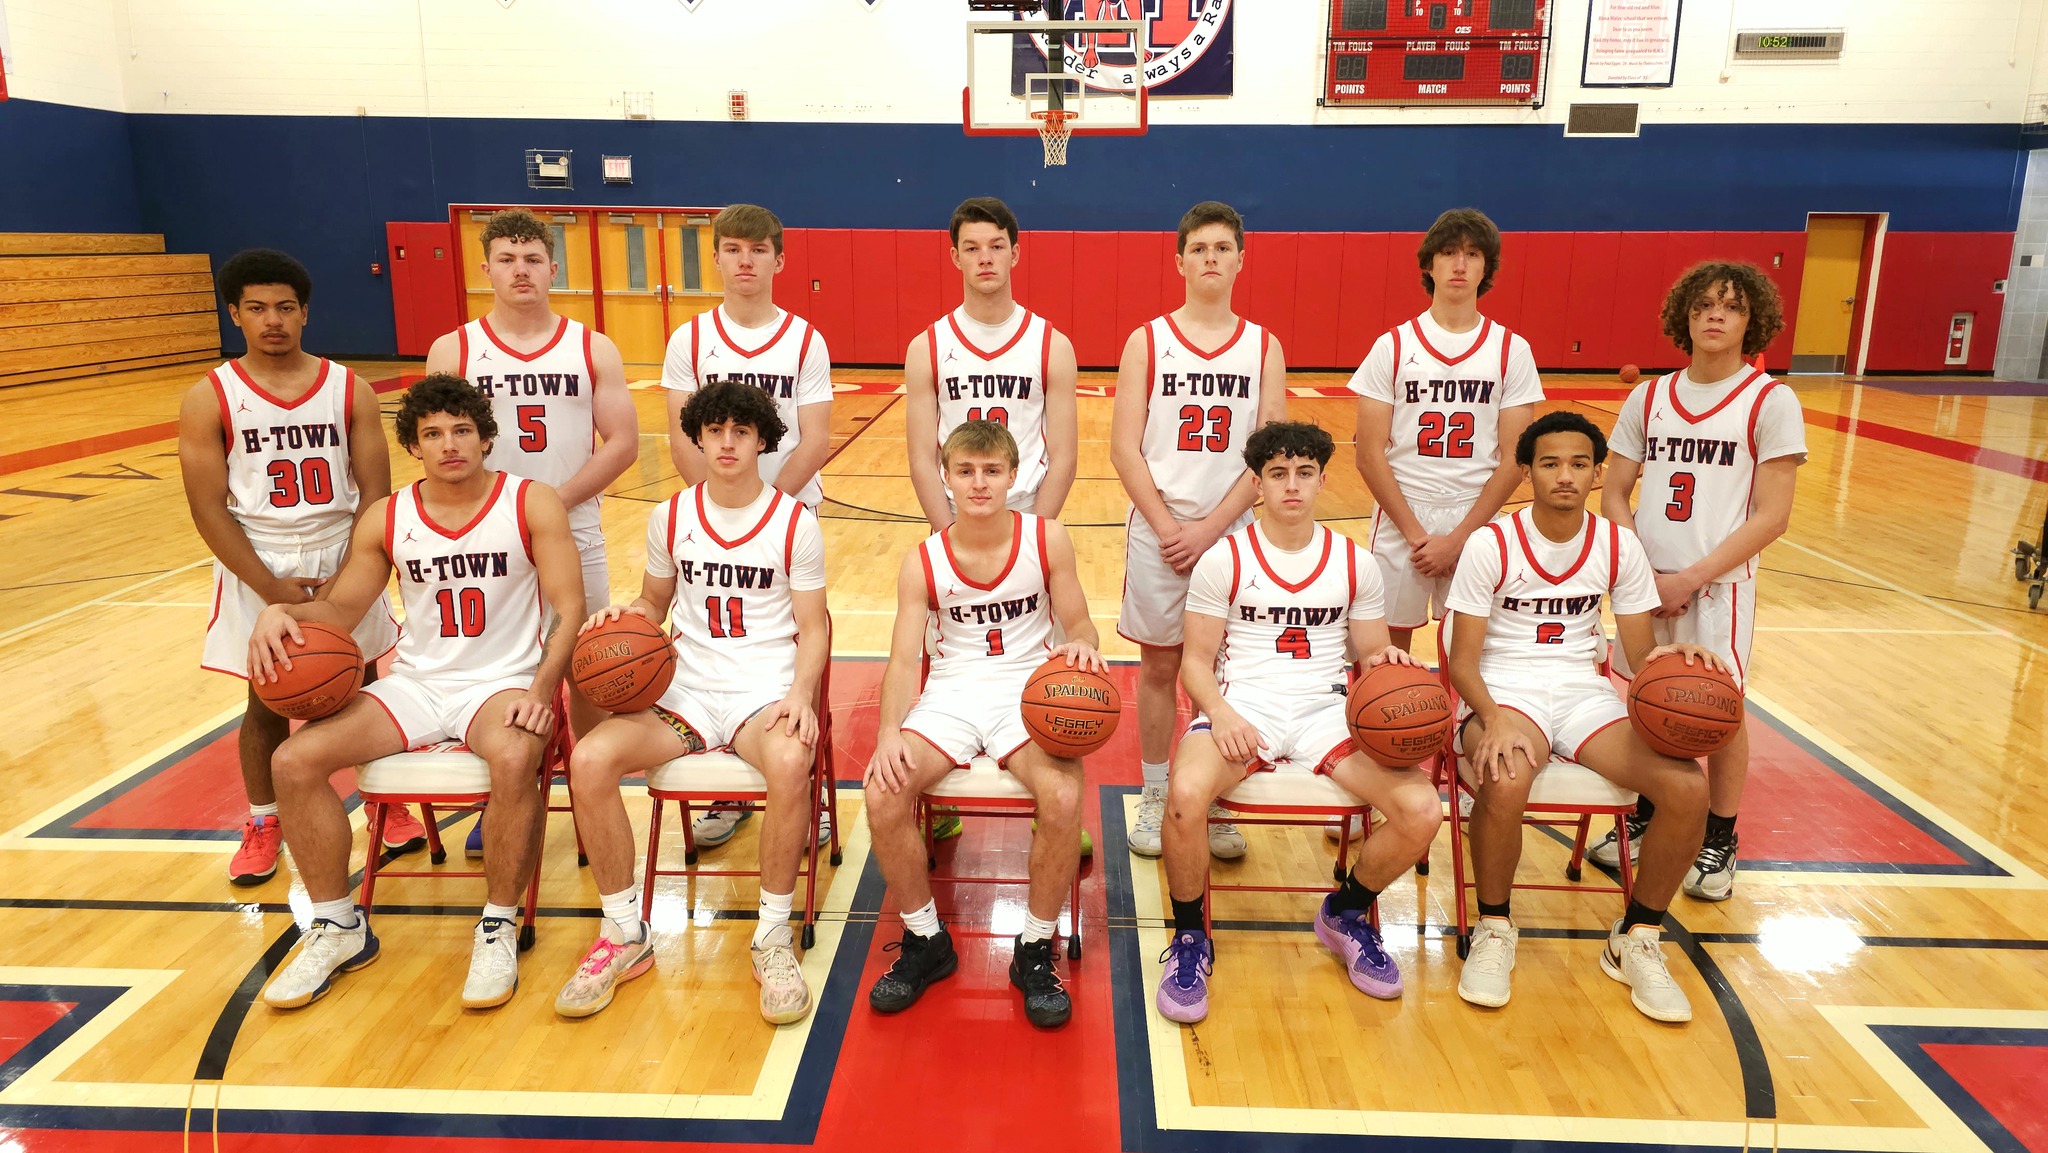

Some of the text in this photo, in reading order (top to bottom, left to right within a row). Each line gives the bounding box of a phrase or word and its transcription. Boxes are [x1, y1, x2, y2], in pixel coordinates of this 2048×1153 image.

[1122, 47, 1192, 84] aways
[1194, 34, 1205, 46] a
[1333, 41, 1373, 52] TM FOULS
[1406, 41, 1471, 51] PLAYER FOULS
[1499, 41, 1540, 51] TM FOULS
[1335, 84, 1365, 94] POINTS
[1418, 84, 1448, 94] MATCH
[1500, 84, 1531, 94] POINTS
[476, 373, 579, 398] H-TOWN
[706, 372, 794, 399] OWN
[945, 374, 1032, 401] H-TOWN
[1162, 373, 1251, 399] H-TOWN
[1405, 379, 1495, 404] H-TOWN
[241, 423, 340, 454] H-TOWN
[516, 404, 548, 453] 5
[1177, 404, 1232, 453] 23
[1417, 411, 1475, 458] 22
[1647, 437, 1738, 466] H-TOWN
[267, 457, 334, 508] 30
[1665, 471, 1696, 522] 3
[406, 552, 508, 583] H-TOWN
[680, 559, 775, 589] H-TOWN
[435, 587, 486, 638] 10
[705, 595, 748, 638] 11
[949, 591, 1039, 625] H-TOWN
[1240, 605, 1344, 627] H-TOWN
[1502, 593, 1602, 615] H-TOWN
[986, 628, 1005, 656] 1
[1275, 626, 1312, 659] 4
[574, 640, 632, 677] SPALDING
[585, 669, 635, 697] LEGACY
[1043, 683, 1111, 706] SPALDING
[1380, 695, 1447, 724] SPALDING
[1663, 686, 1737, 717] SPALDING
[1045, 713, 1104, 730] LEGACY
[1662, 717, 1728, 739] LEGACY
[1391, 725, 1448, 747] LEGACY
